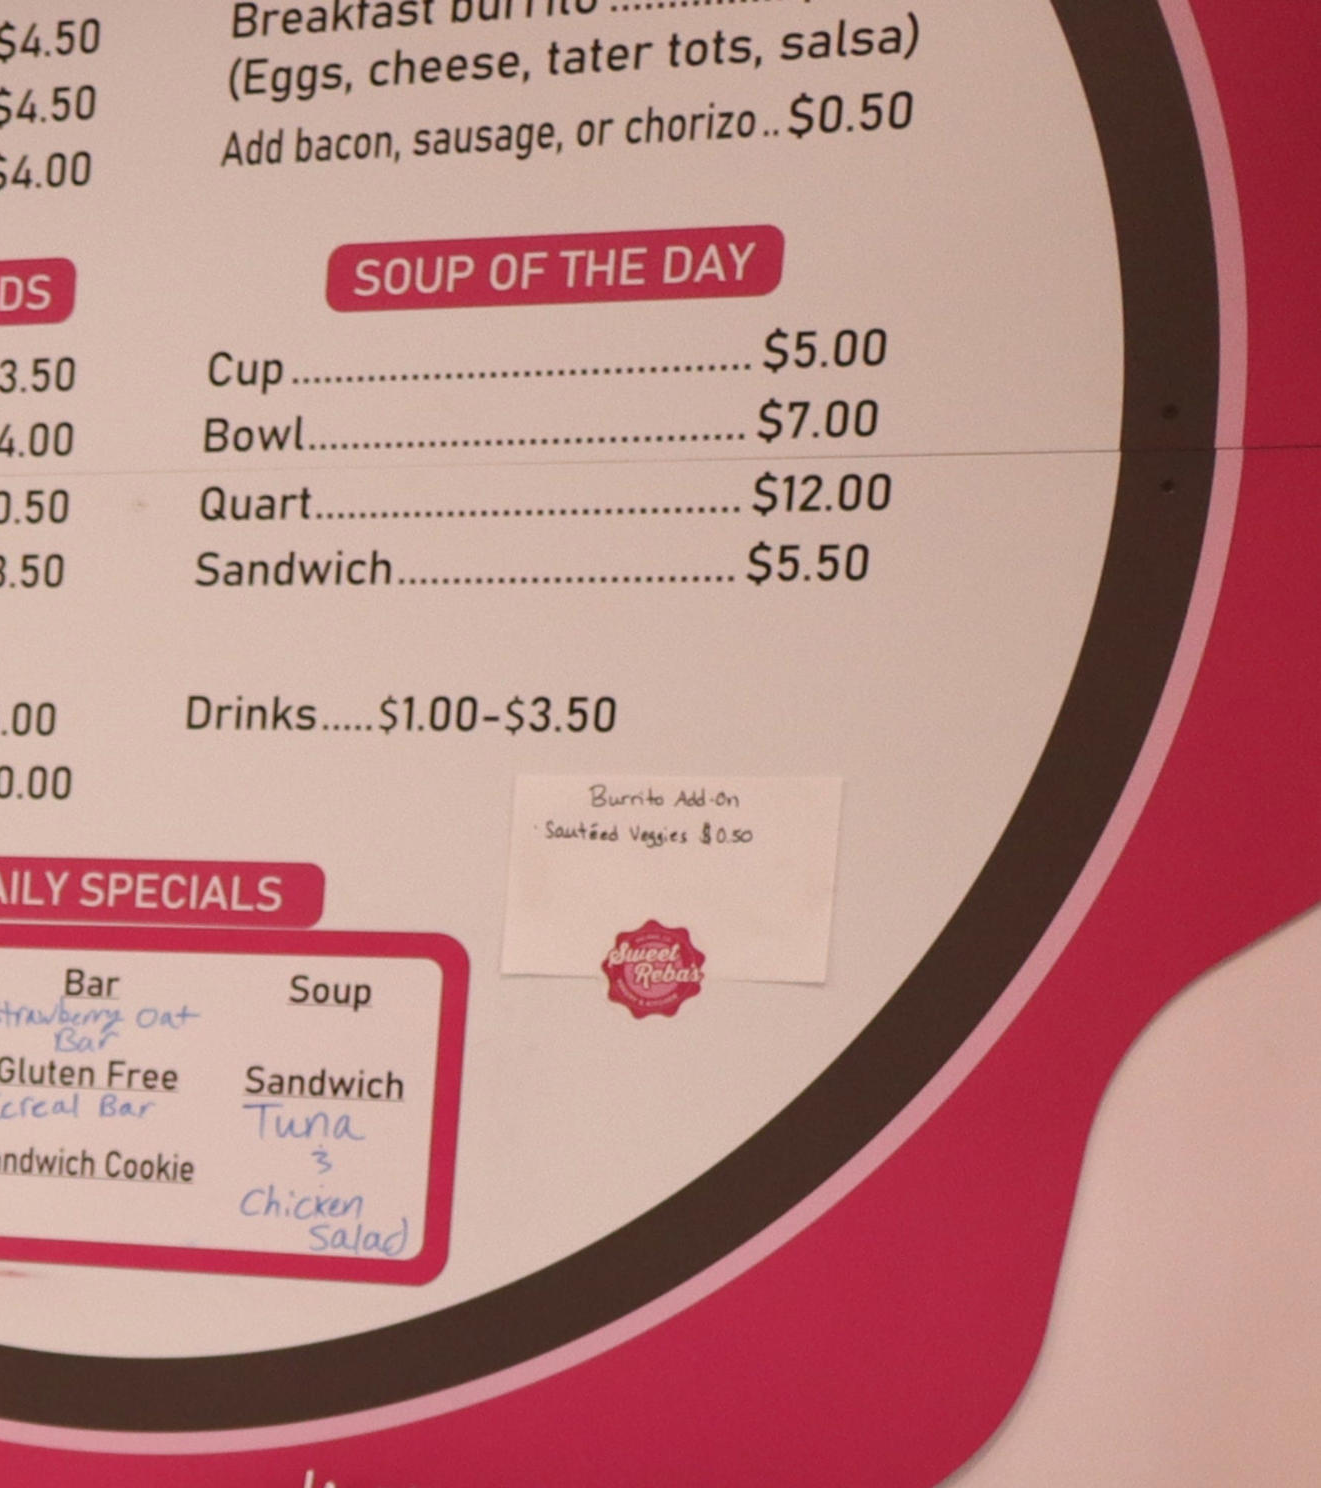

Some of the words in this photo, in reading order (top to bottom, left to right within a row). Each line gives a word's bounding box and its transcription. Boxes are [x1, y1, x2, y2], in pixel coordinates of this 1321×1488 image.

[232, 0, 433, 38] Breakfast
[227, 55, 355, 103] (Eggs,
[368, 48, 532, 88] cheese,
[547, 38, 652, 76] tater
[668, 30, 764, 70] tots,
[780, 12, 920, 62] salsa)
[221, 129, 283, 167] Add
[294, 122, 403, 165] bacon,
[413, 120, 563, 161] sausage,
[575, 117, 614, 147] or
[624, 103, 756, 144] chorizo
[786, 90, 914, 140] $0.50
[353, 255, 474, 297] SOUP
[488, 251, 547, 291] OF
[559, 246, 647, 288] THE
[662, 241, 757, 283] DAY
[207, 350, 284, 393] Cup
[762, 326, 888, 372] $5.00
[203, 416, 305, 453] Bowl
[756, 397, 879, 444] $7.00
[199, 485, 313, 522] Quart
[751, 472, 892, 517] $12.00
[194, 549, 393, 587] Sandwich
[746, 541, 870, 586] $5.50
[185, 695, 318, 731] Drinks
[378, 695, 618, 735] $1.00-$3.50
[589, 784, 664, 807] Burrito
[674, 788, 740, 807] Add-On
[629, 825, 687, 848] Veggies
[80, 871, 283, 912] SPECIALS
[607, 941, 680, 968] Sweet
[64, 969, 120, 999] Bar
[289, 976, 372, 1012] Soup
[136, 1005, 200, 1029] Oat
[55, 1027, 119, 1052] Bar
[108, 1060, 179, 1090] Free
[245, 1065, 404, 1100] Sandwich
[99, 1094, 156, 1118] Bar
[242, 1103, 365, 1140] Tuna
[104, 1151, 196, 1184] Cookie
[240, 1184, 363, 1220] Chicken
[309, 1216, 408, 1257] Salad
